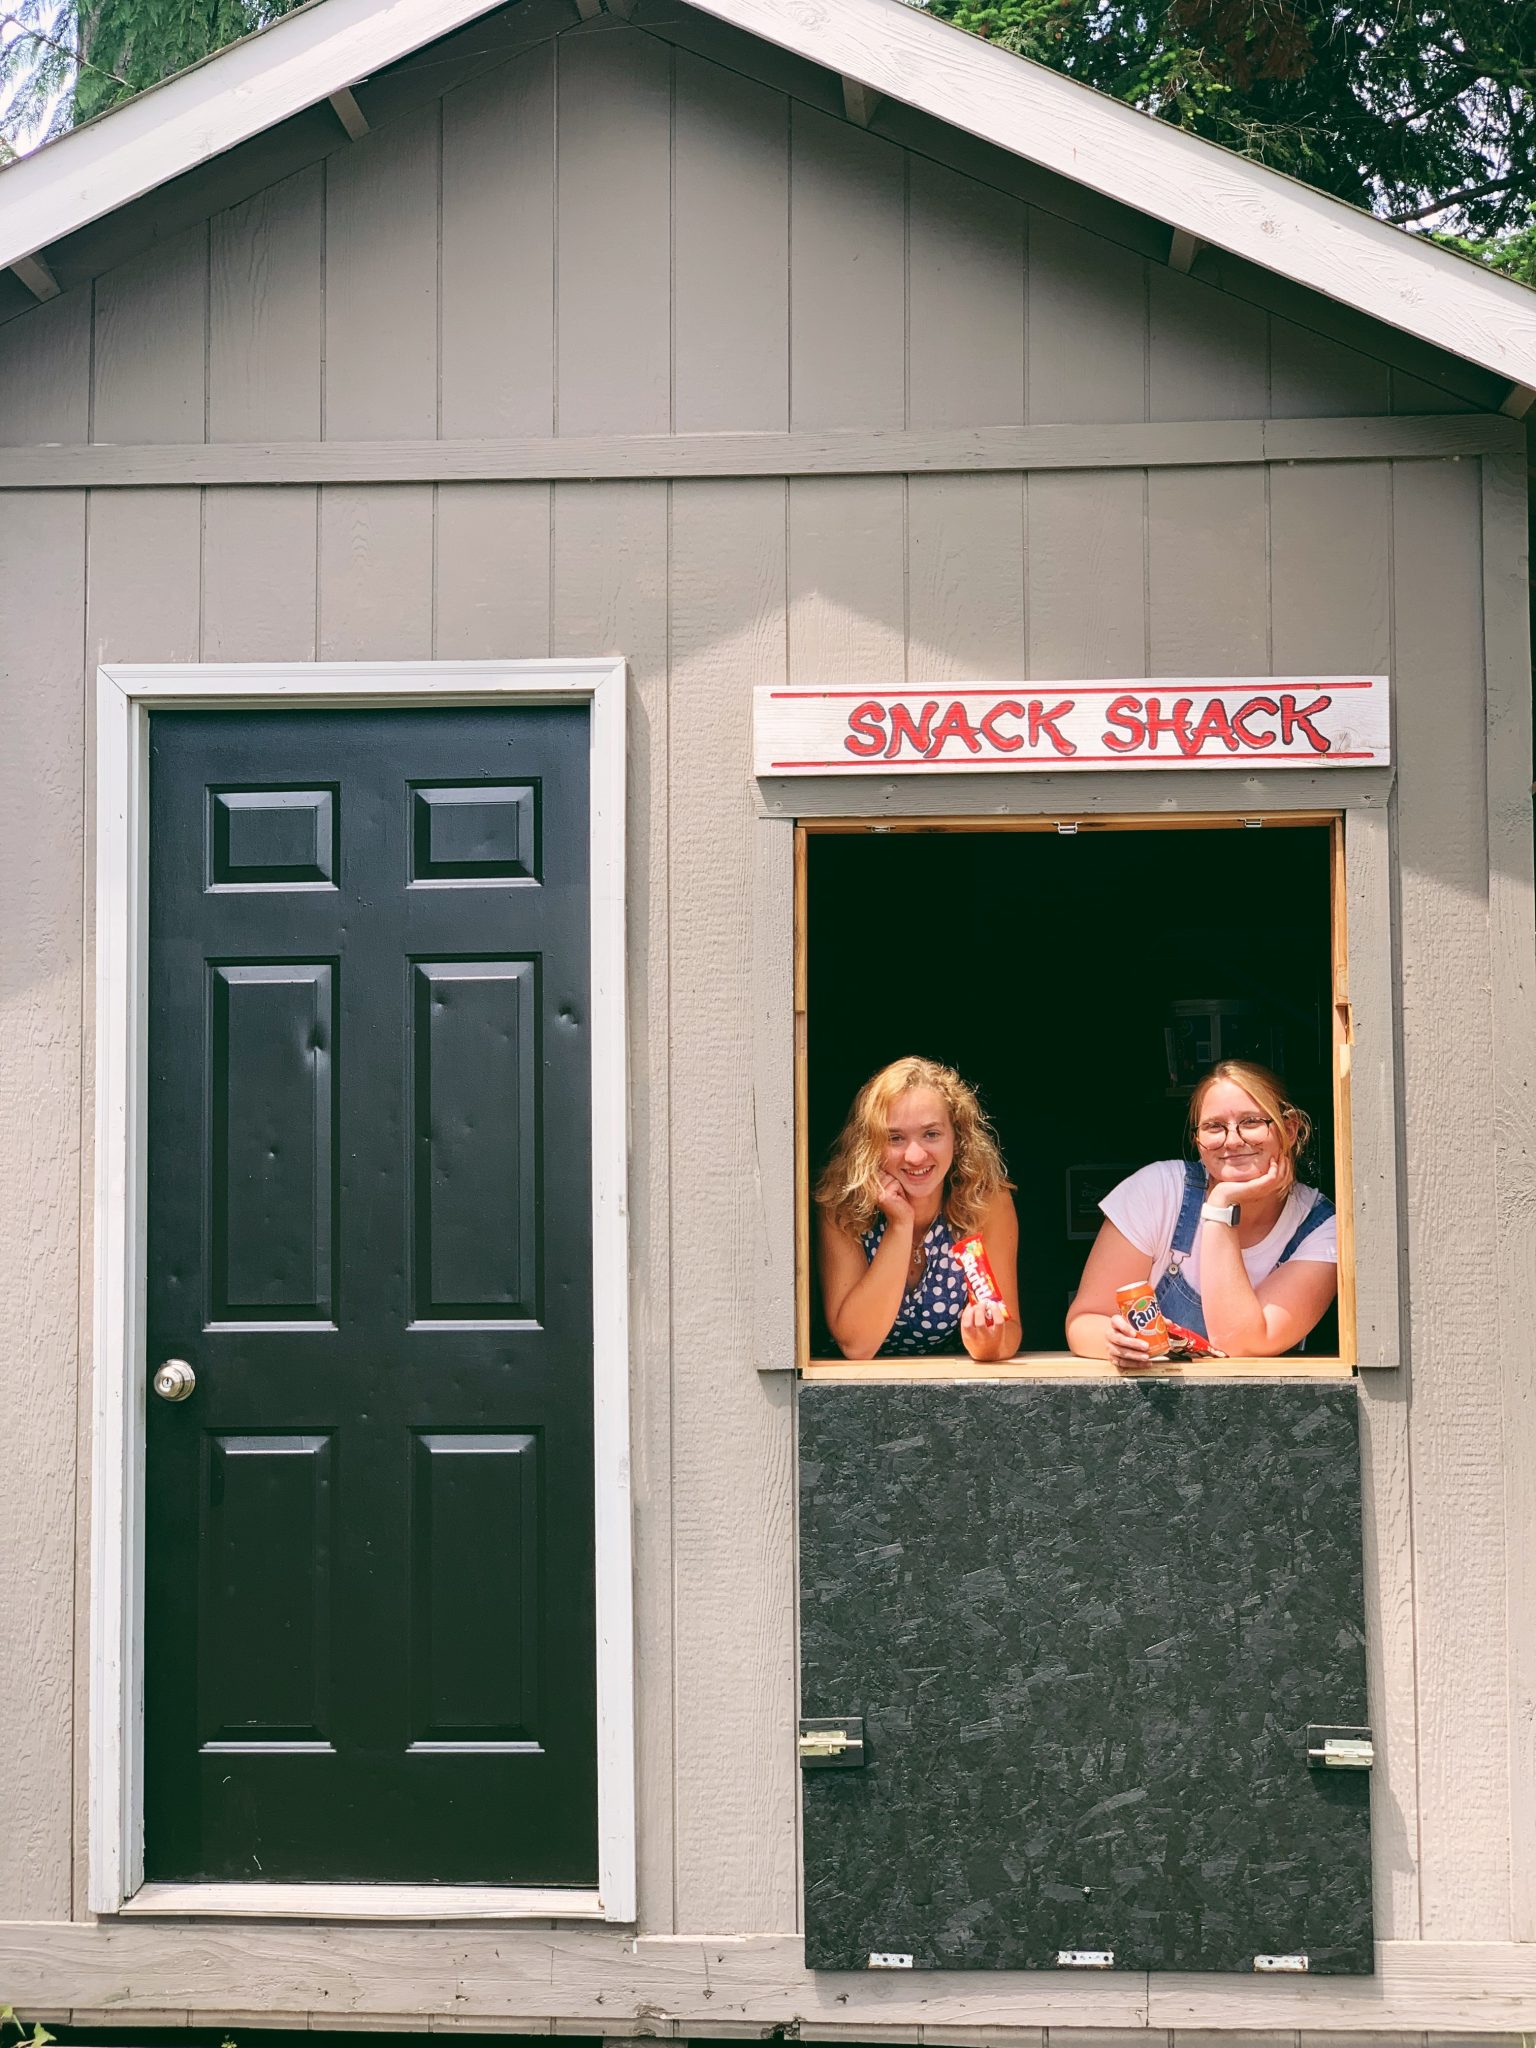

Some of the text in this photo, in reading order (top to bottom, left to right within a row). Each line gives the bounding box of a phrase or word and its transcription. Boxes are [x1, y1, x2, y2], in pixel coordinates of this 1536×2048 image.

[844, 695, 1332, 758] SNACK SHACK
[959, 1252, 994, 1302] Skittl
